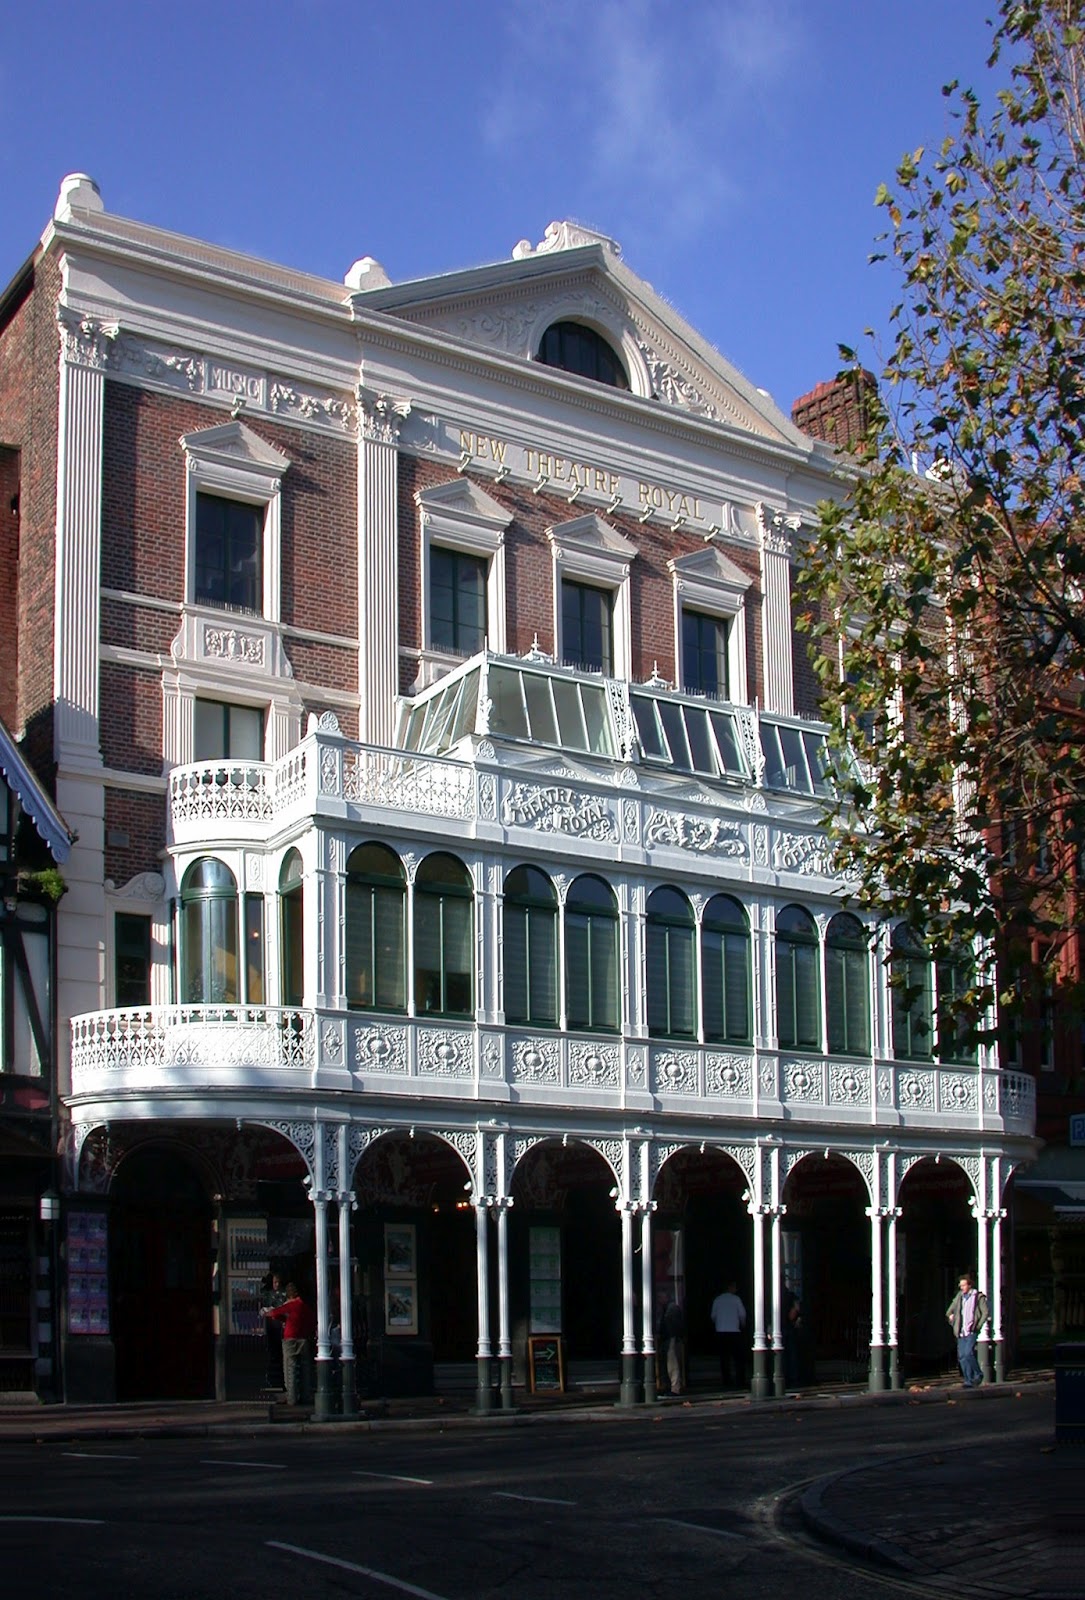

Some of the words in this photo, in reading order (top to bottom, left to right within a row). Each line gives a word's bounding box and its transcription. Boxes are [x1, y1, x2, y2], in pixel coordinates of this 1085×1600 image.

[211, 366, 258, 398] MUSIC
[458, 431, 508, 463] NEW
[523, 448, 620, 494] THEATRE
[638, 482, 705, 521] ROYAL
[511, 787, 576, 822] THEATRE
[560, 803, 607, 832] ROYAL
[783, 835, 828, 867] OPERA
